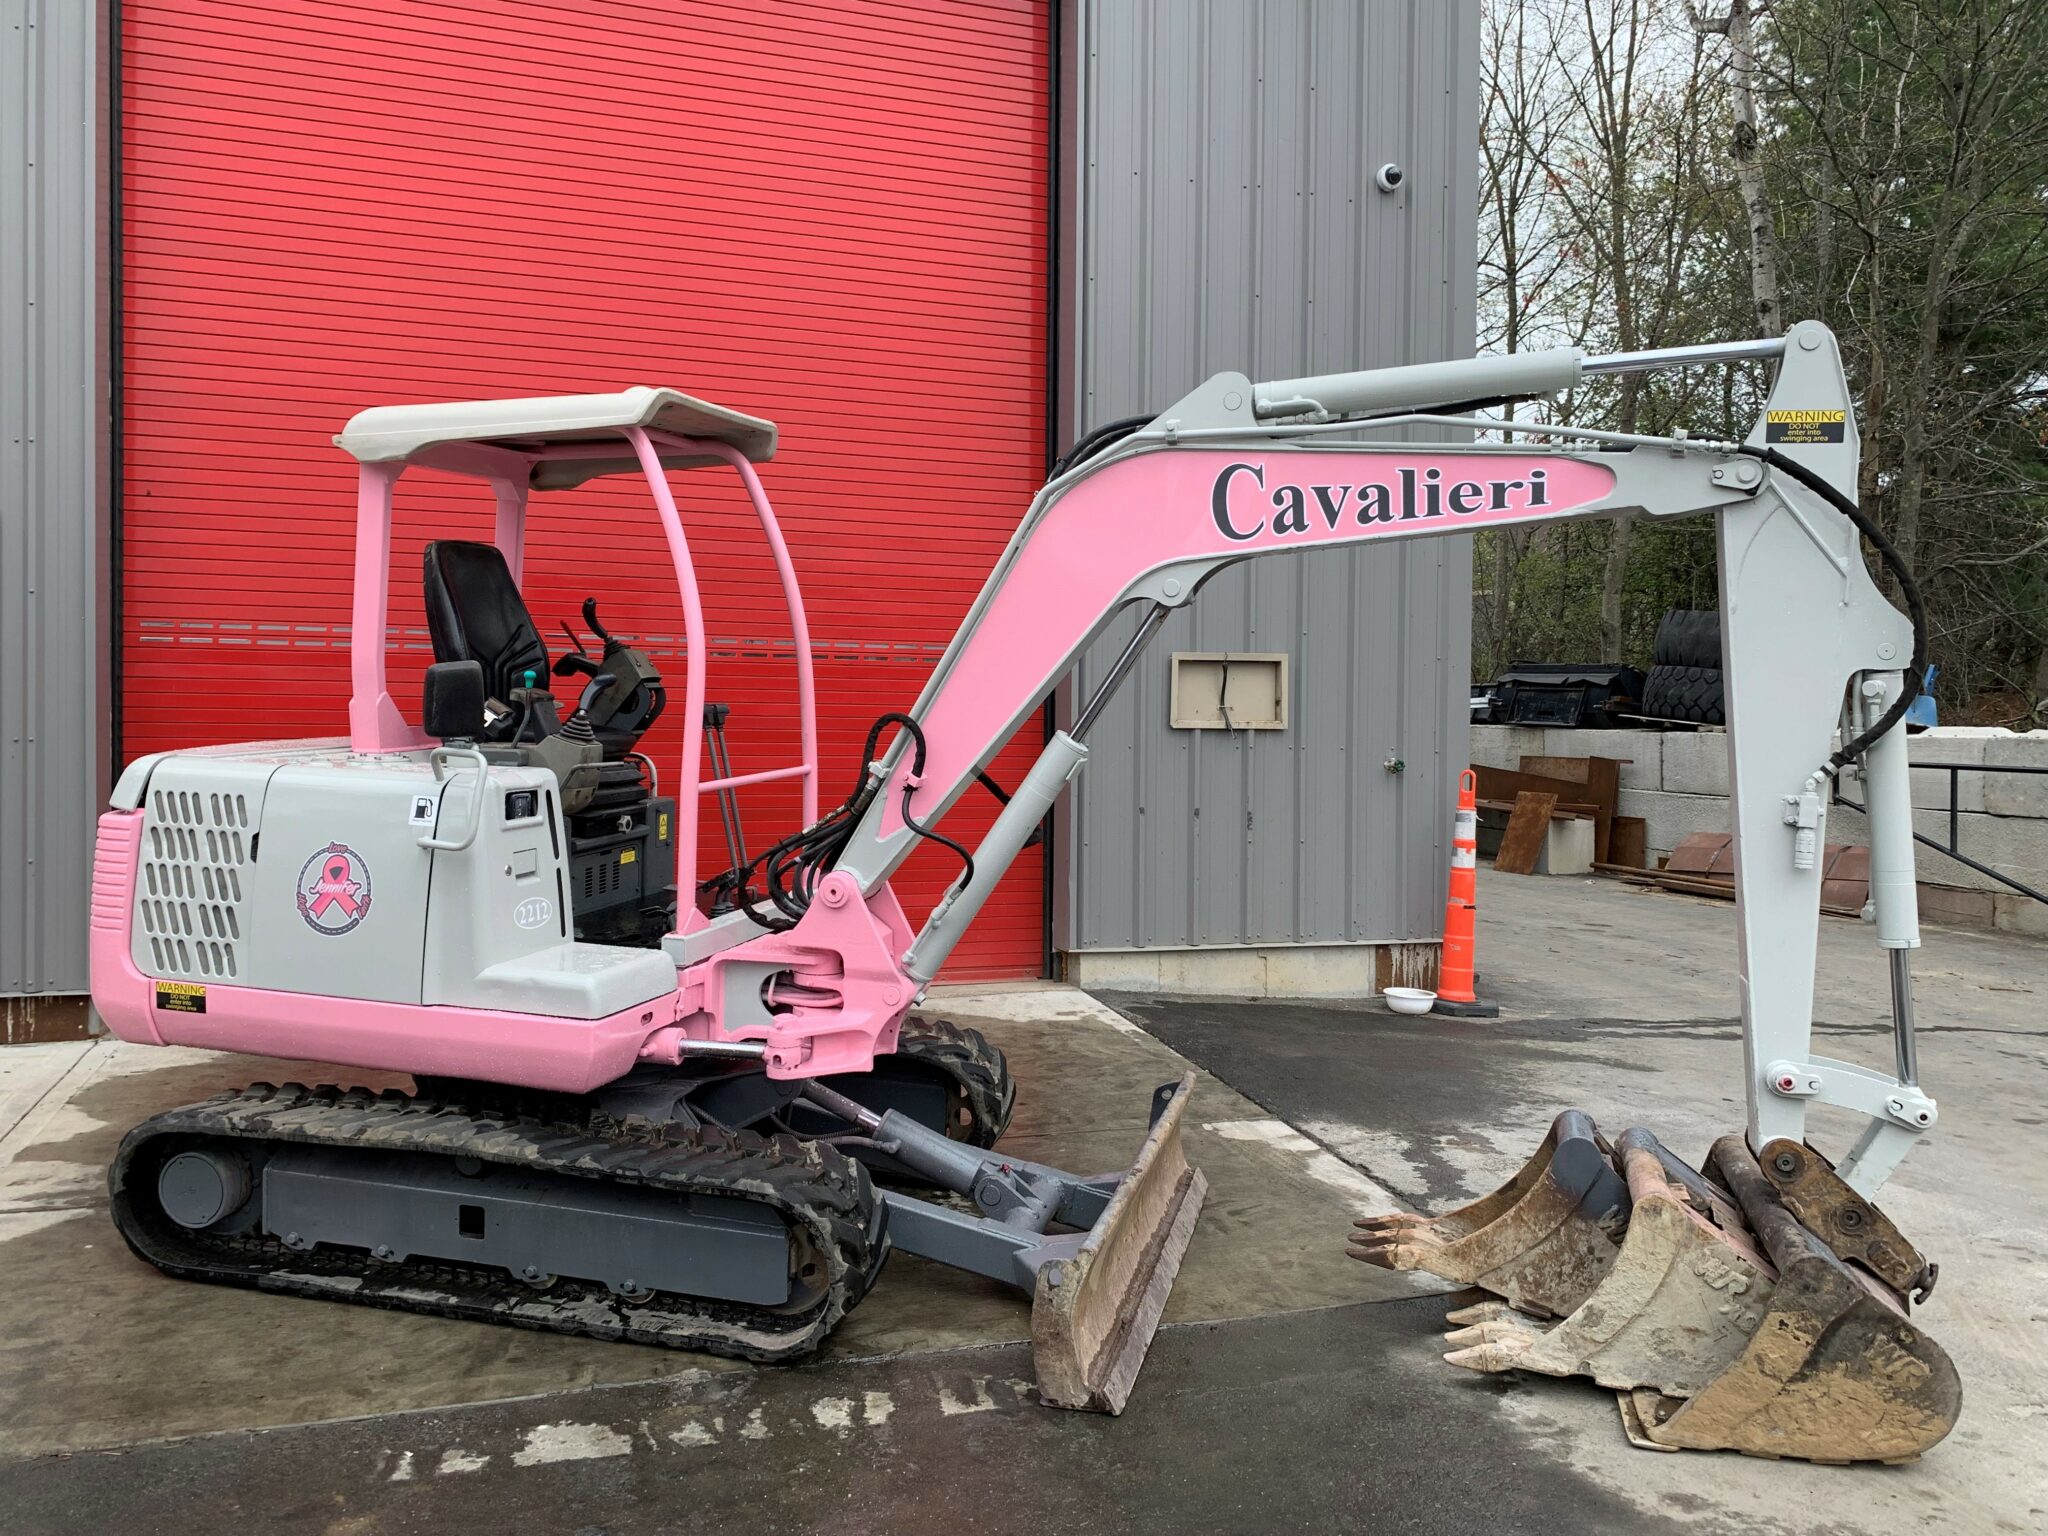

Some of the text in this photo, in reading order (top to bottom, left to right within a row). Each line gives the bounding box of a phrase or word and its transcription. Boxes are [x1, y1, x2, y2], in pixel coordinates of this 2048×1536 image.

[1769, 411, 1844, 422] WARNING
[1780, 435, 1812, 443] swinging
[1212, 464, 1550, 541] Cavalieri
[328, 842, 348, 853] Love
[519, 902, 549, 925] 2212
[157, 981, 207, 997] WARNING
